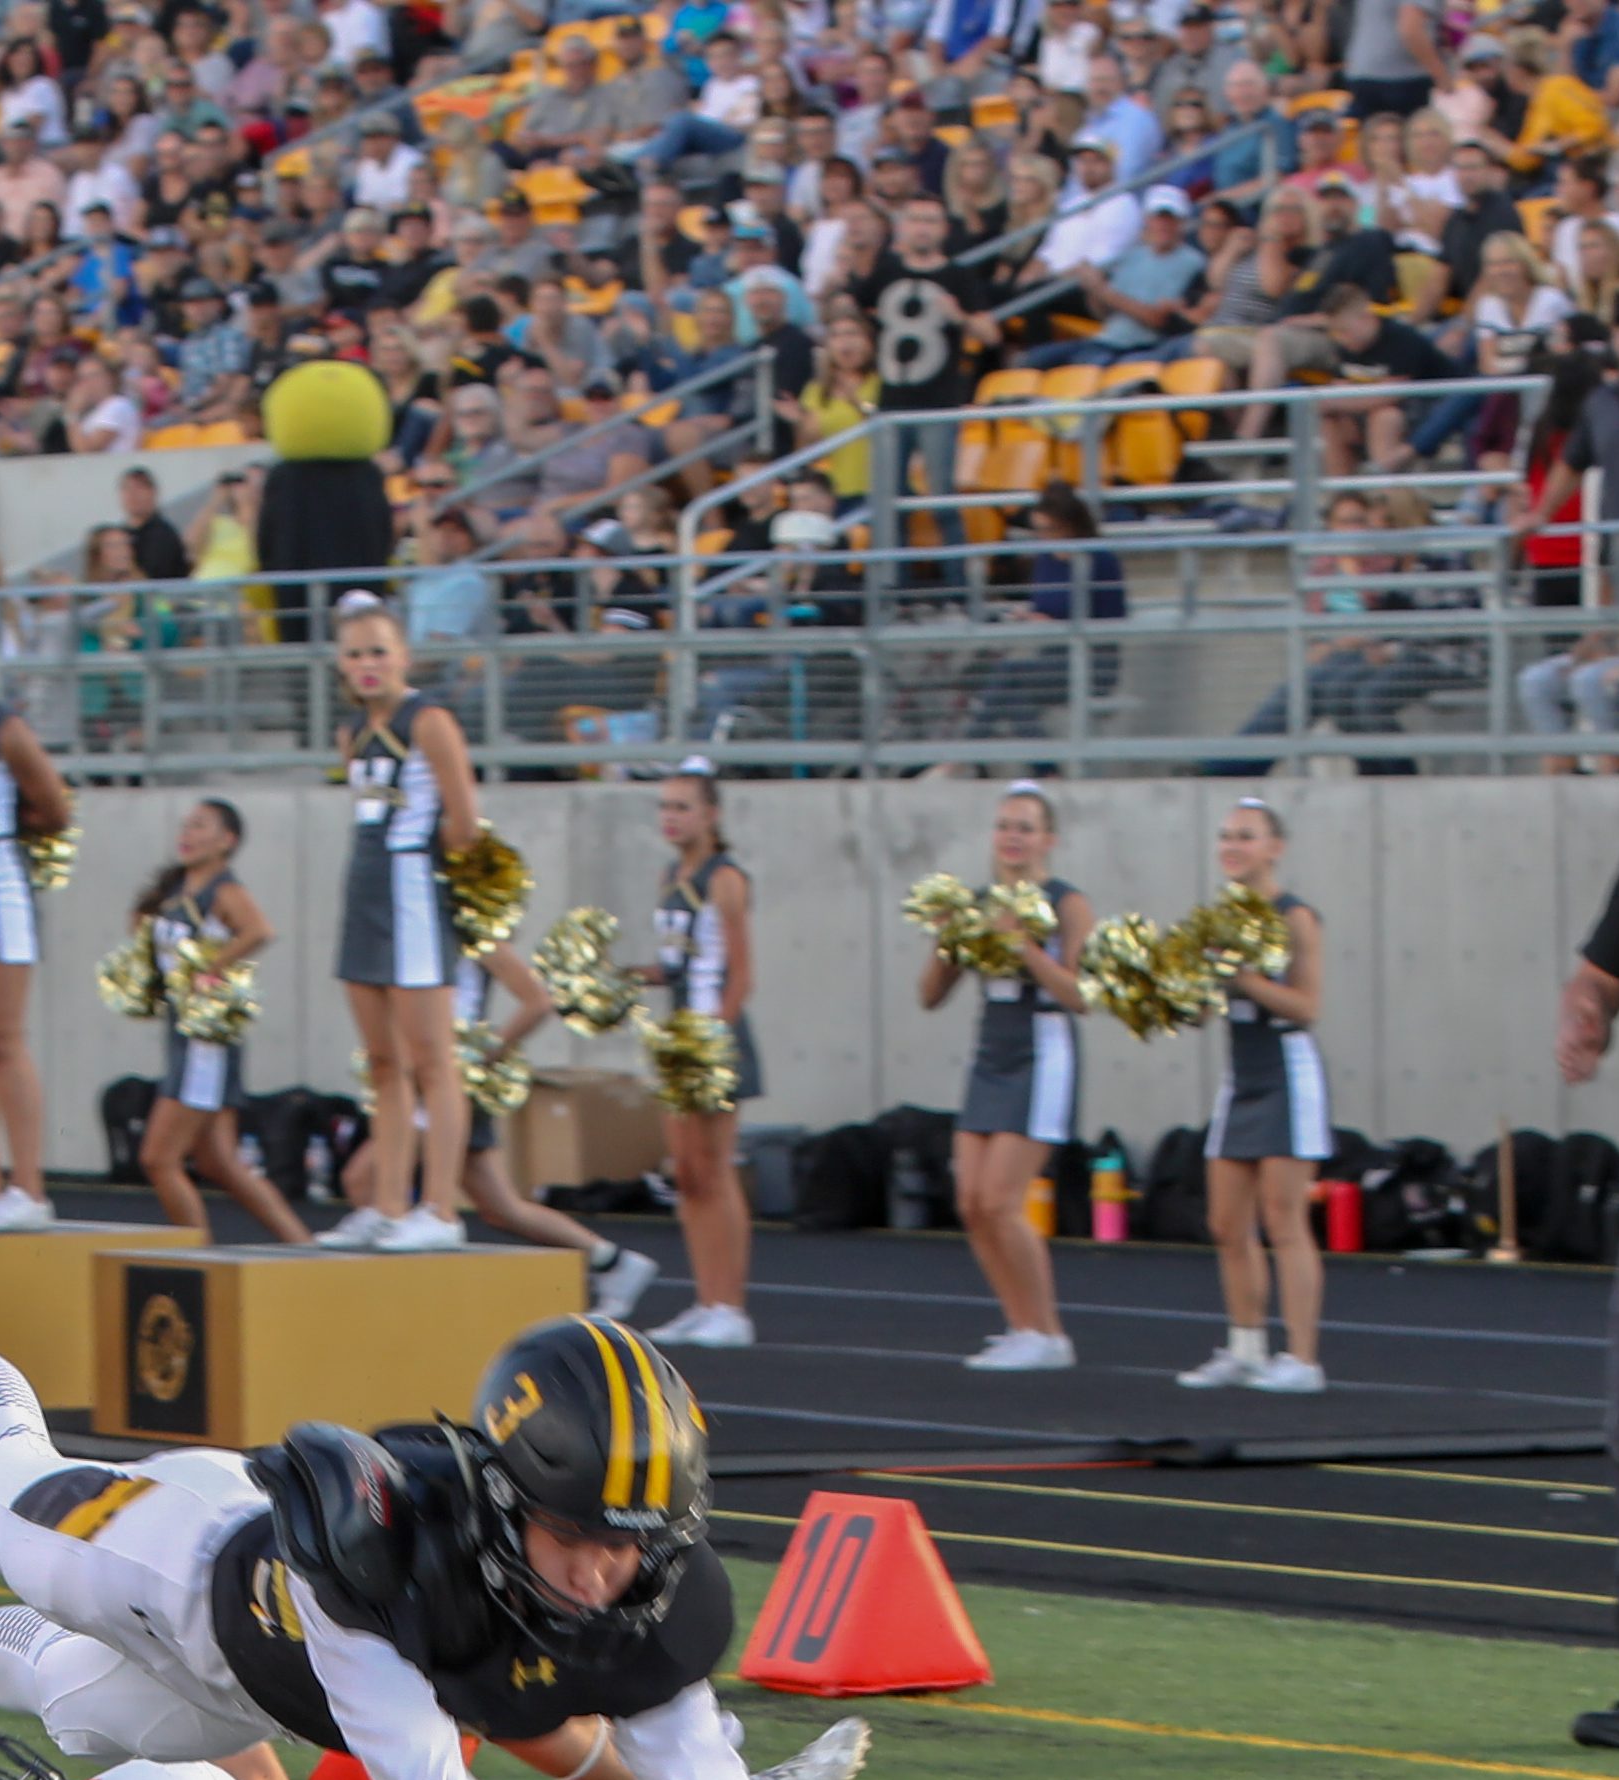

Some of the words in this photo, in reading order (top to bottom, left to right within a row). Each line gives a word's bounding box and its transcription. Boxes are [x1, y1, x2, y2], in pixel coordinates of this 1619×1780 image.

[877, 277, 949, 387] 8
[484, 1371, 544, 1446] 3
[764, 1512, 876, 1664] 10
